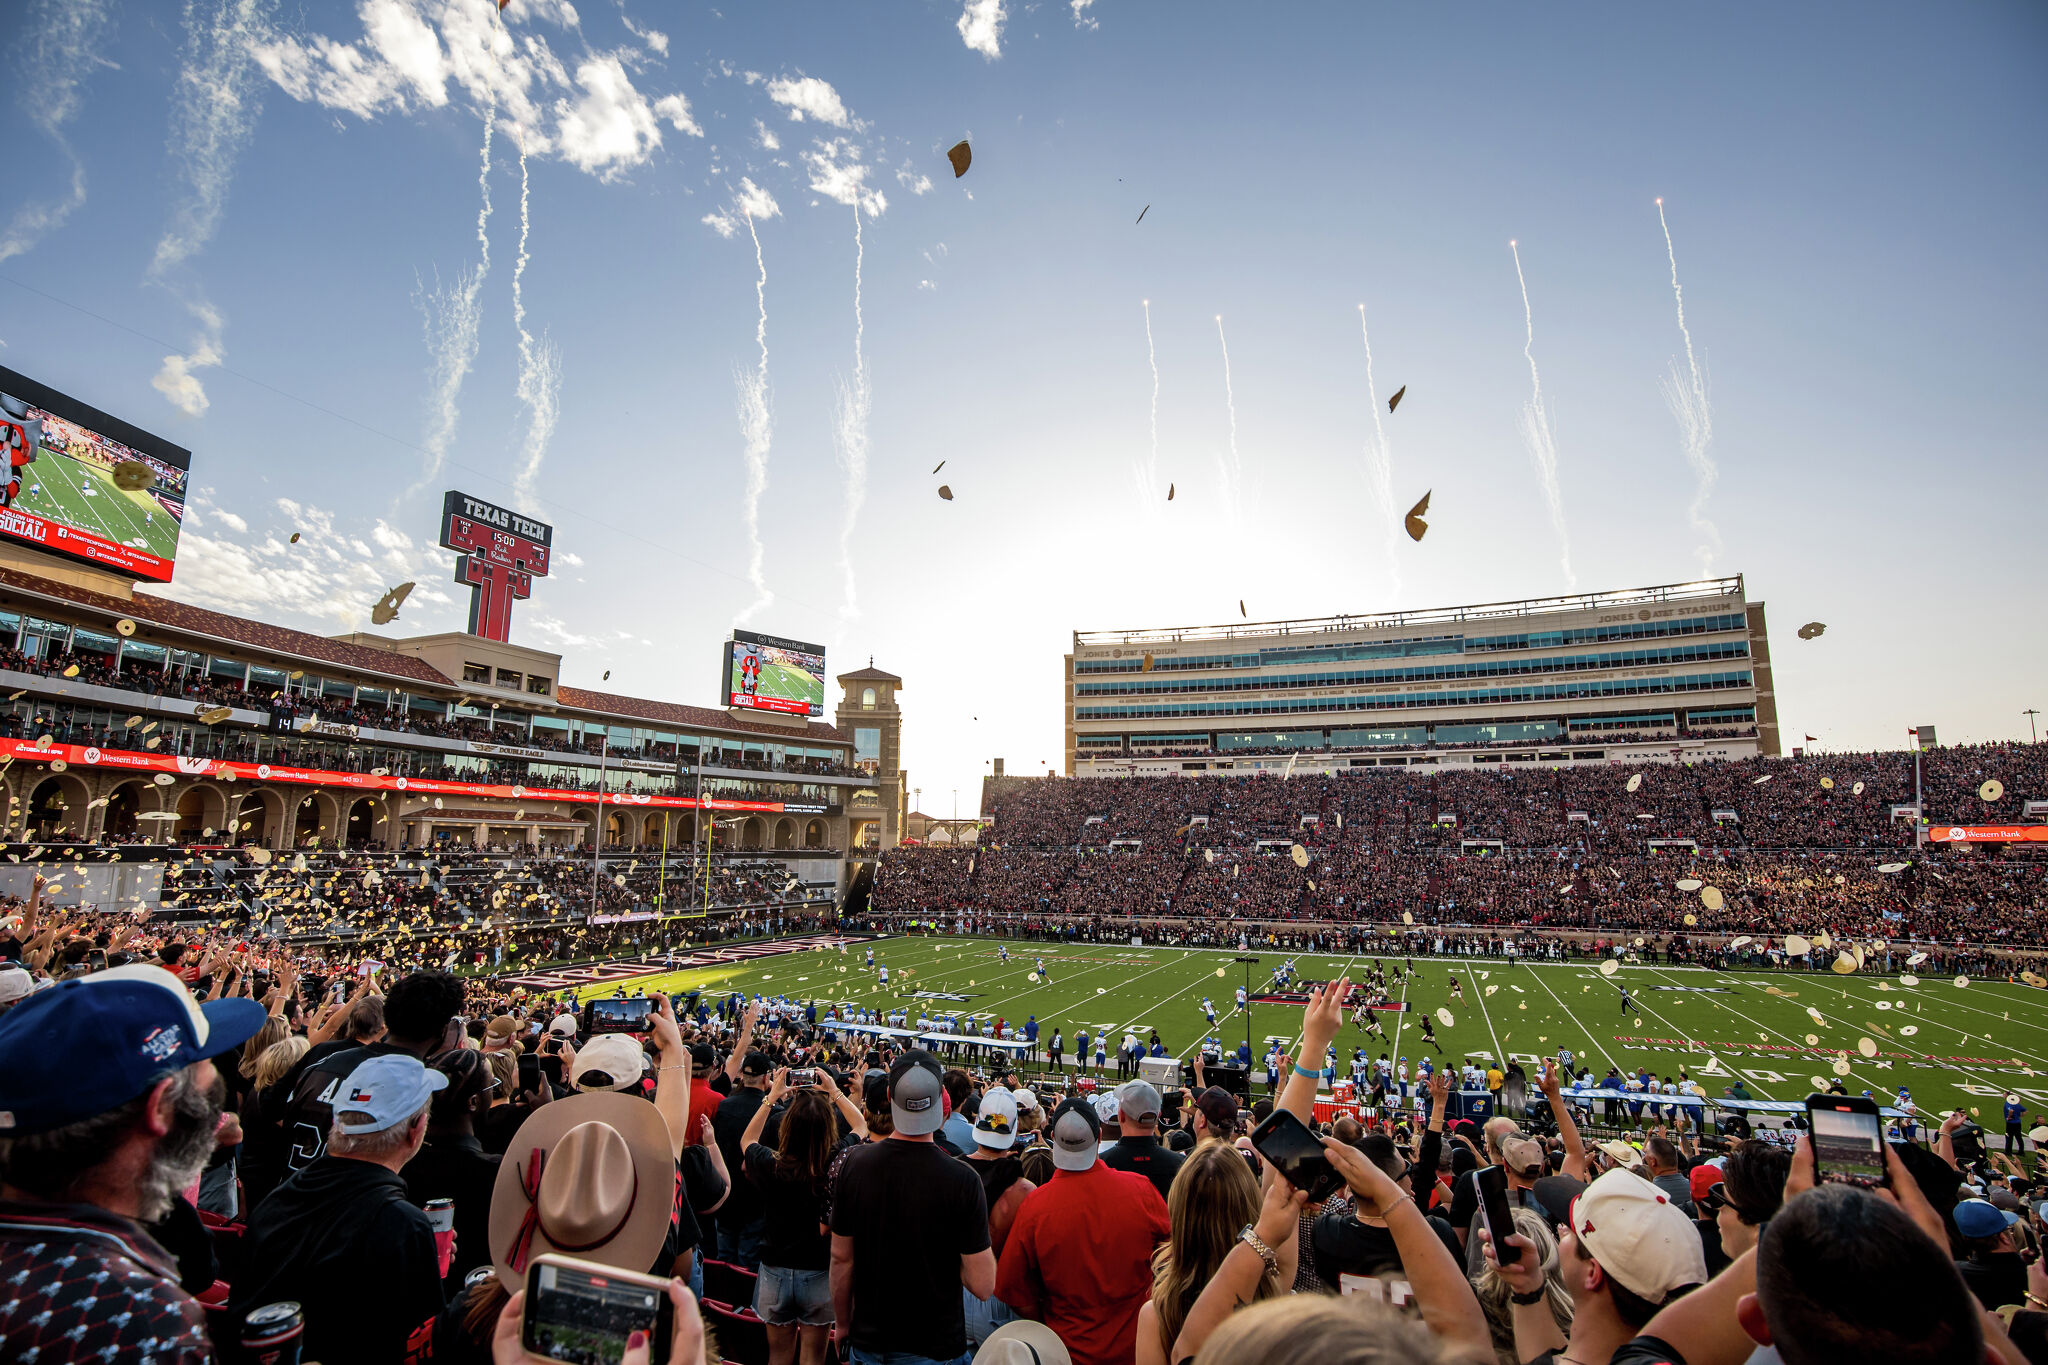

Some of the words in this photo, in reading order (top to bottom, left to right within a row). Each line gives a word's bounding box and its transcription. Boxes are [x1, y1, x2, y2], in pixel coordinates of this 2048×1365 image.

[2, 510, 26, 521] FOLLOW
[464, 498, 509, 528] TEXAS
[512, 515, 545, 540] TECH
[462, 526, 468, 534] 0
[494, 532, 515, 547] 15:00
[1599, 612, 1634, 623] JONES
[1652, 609, 1674, 618] AT&T
[1678, 603, 1730, 615] STADIUM
[768, 637, 792, 648] Western
[792, 642, 805, 651] Bank
[279, 718, 290, 730] 14
[500, 747, 524, 755] DOUBLE
[102, 754, 130, 764] Western
[132, 756, 149, 765] Bank
